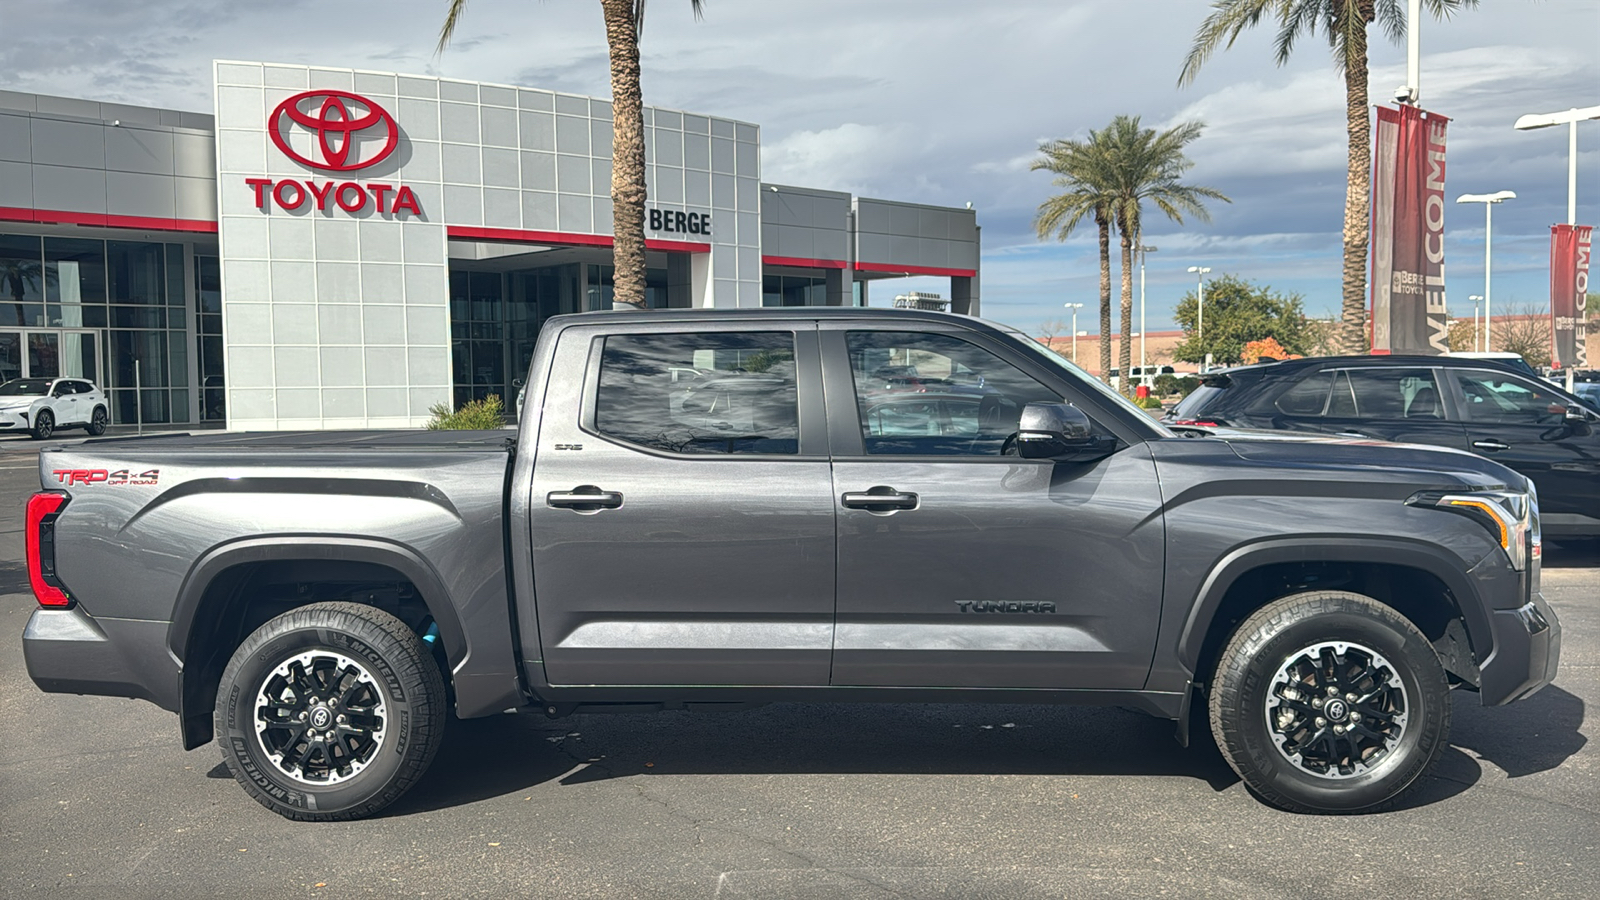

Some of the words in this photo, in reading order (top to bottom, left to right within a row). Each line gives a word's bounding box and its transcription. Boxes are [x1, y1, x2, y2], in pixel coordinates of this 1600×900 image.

[245, 178, 421, 215] TOYOTA
[649, 208, 711, 236] BERGE
[1424, 120, 1450, 356] WELCOME
[1401, 285, 1424, 295] TOYOA
[1575, 229, 1592, 367] WELCOME
[53, 469, 108, 485] TRD
[954, 600, 1057, 614] TUNDRA
[350, 641, 404, 699] MICHELIN
[233, 741, 286, 799] MICHELIN
